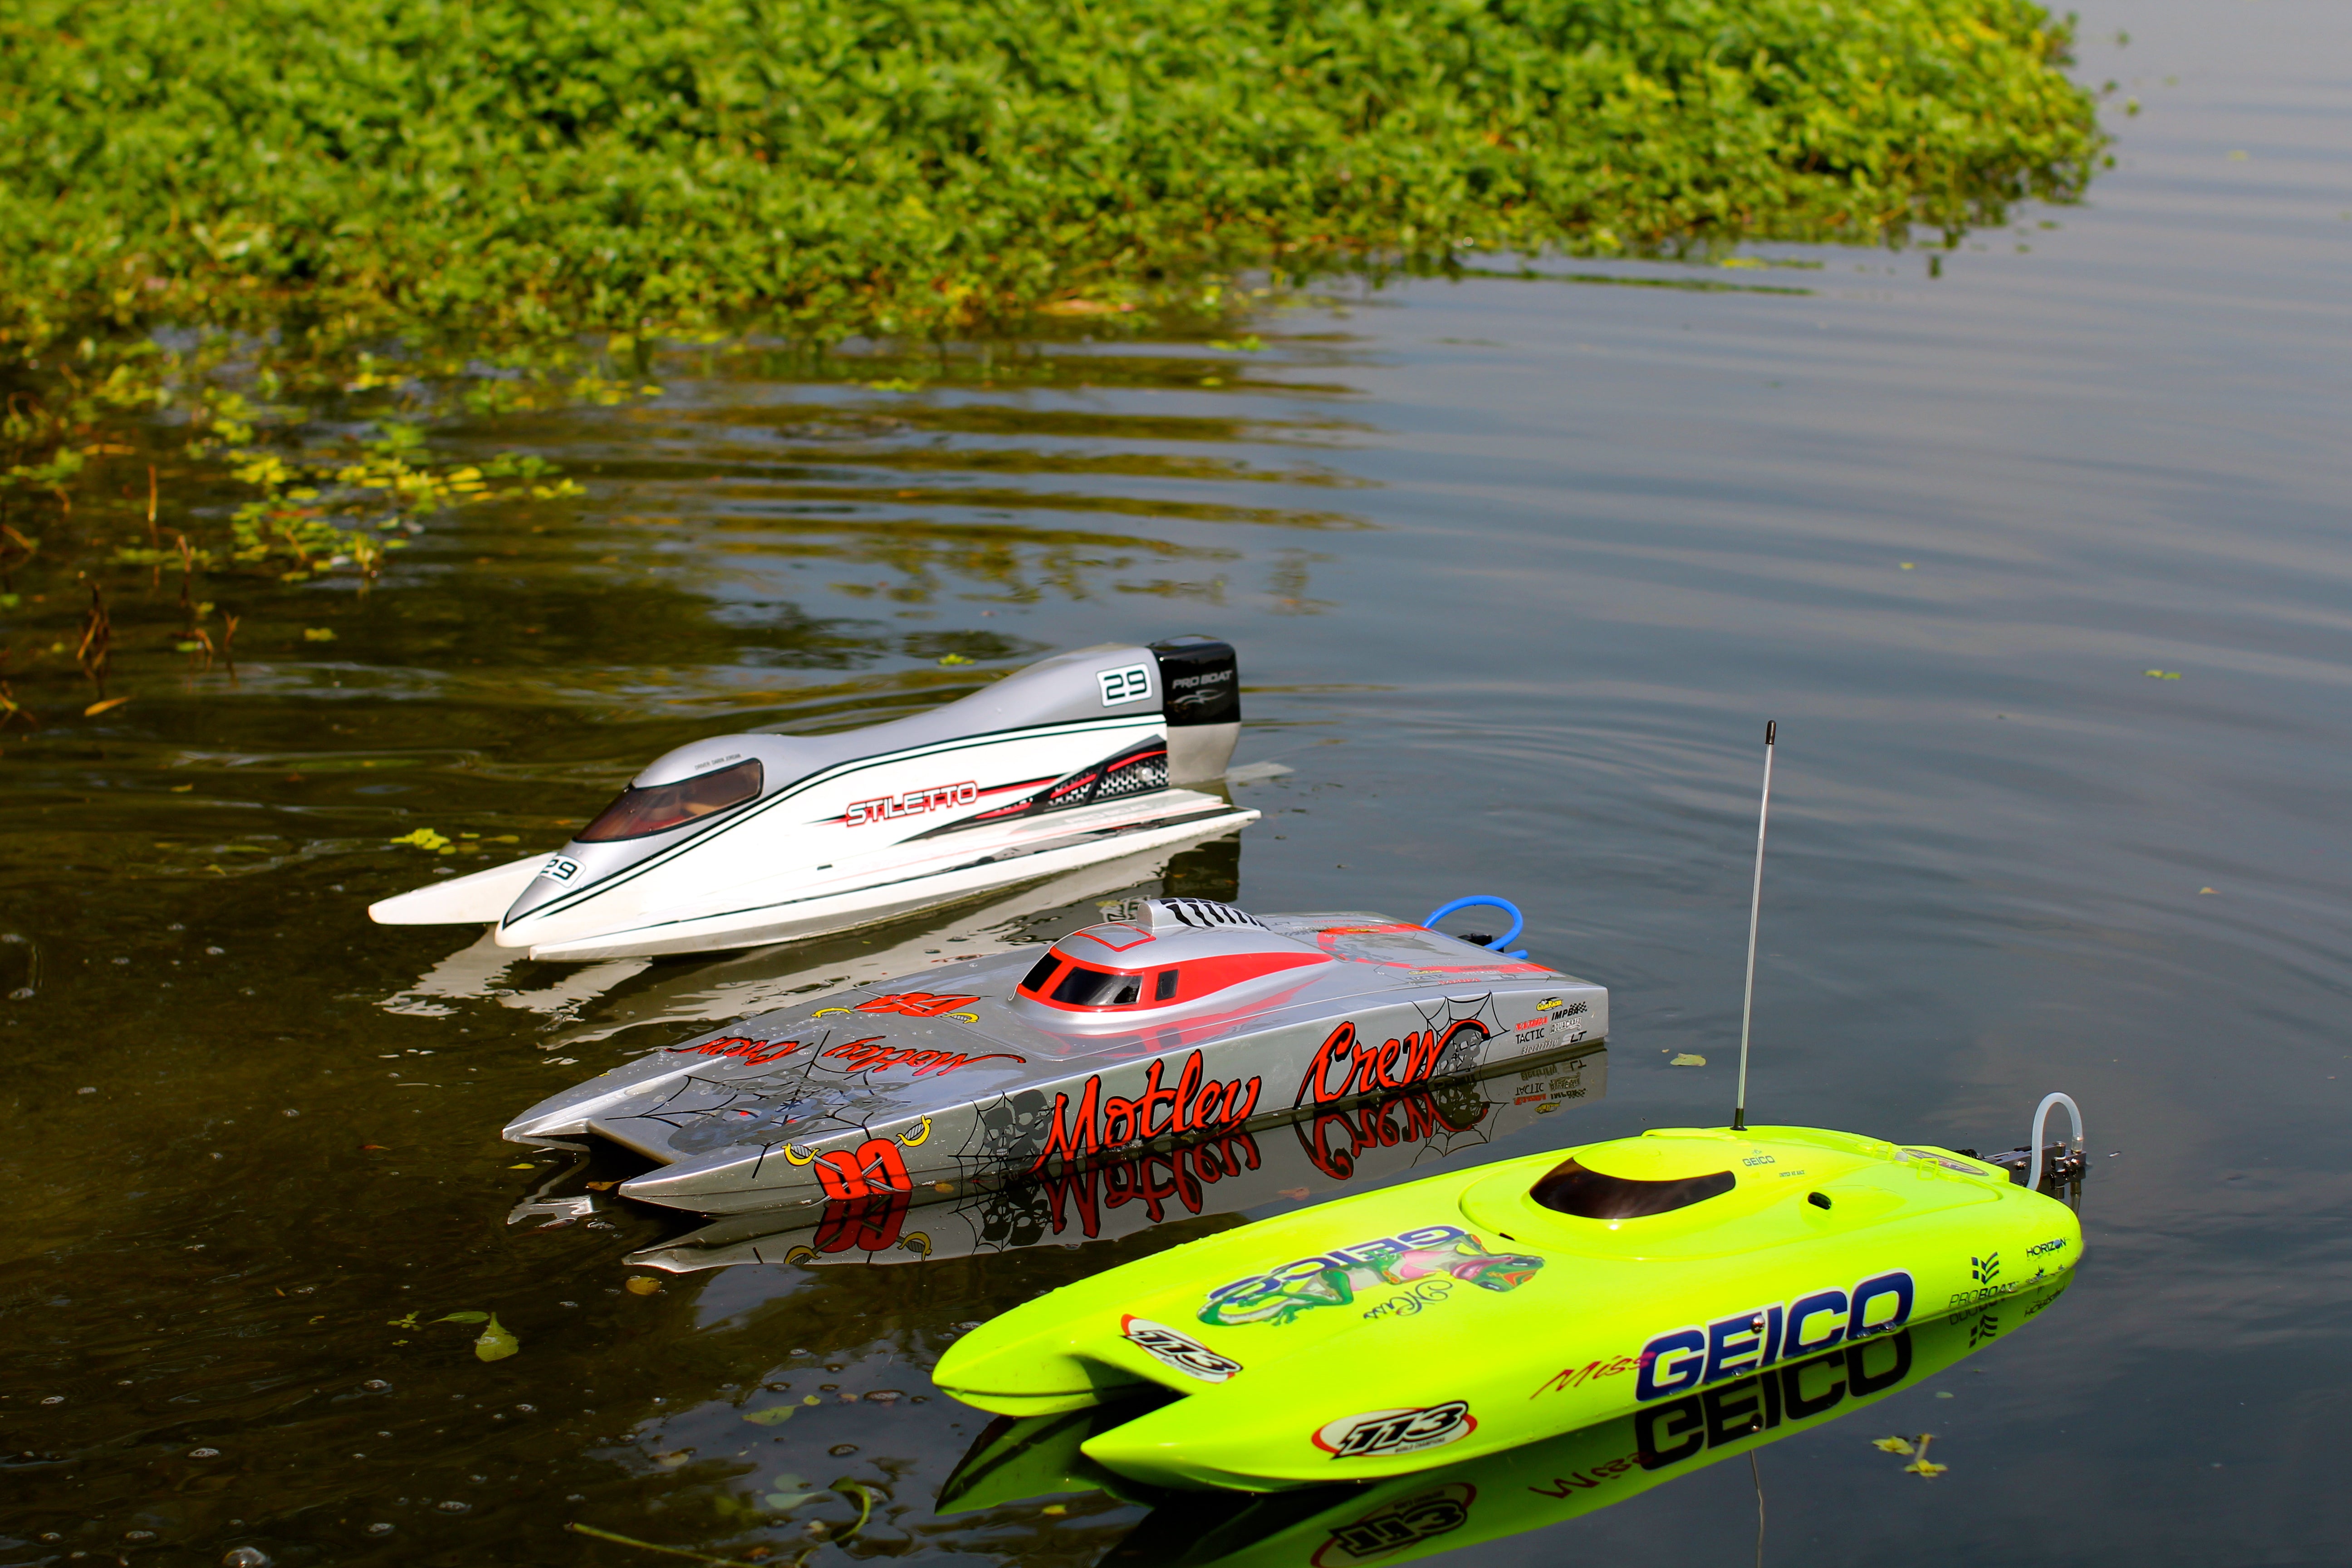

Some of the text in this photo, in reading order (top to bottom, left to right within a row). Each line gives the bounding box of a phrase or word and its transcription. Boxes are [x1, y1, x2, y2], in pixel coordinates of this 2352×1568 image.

[1104, 670, 1147, 700] 29
[1172, 670, 1233, 689] PRO BOAT
[846, 780, 978, 828] STILETTO
[1551, 1006, 1578, 1021] IMPBA
[1516, 1028, 1544, 1044] TACTIC
[666, 1036, 1026, 1076] Motley Crew
[1018, 1021, 1491, 1176] Motley Crew
[1742, 1155, 1775, 1166] GEICO
[2026, 1237, 2066, 1258] HORIZON
[1529, 1269, 1914, 1402] Miss GEICO
[1330, 1400, 1469, 1461] 113
